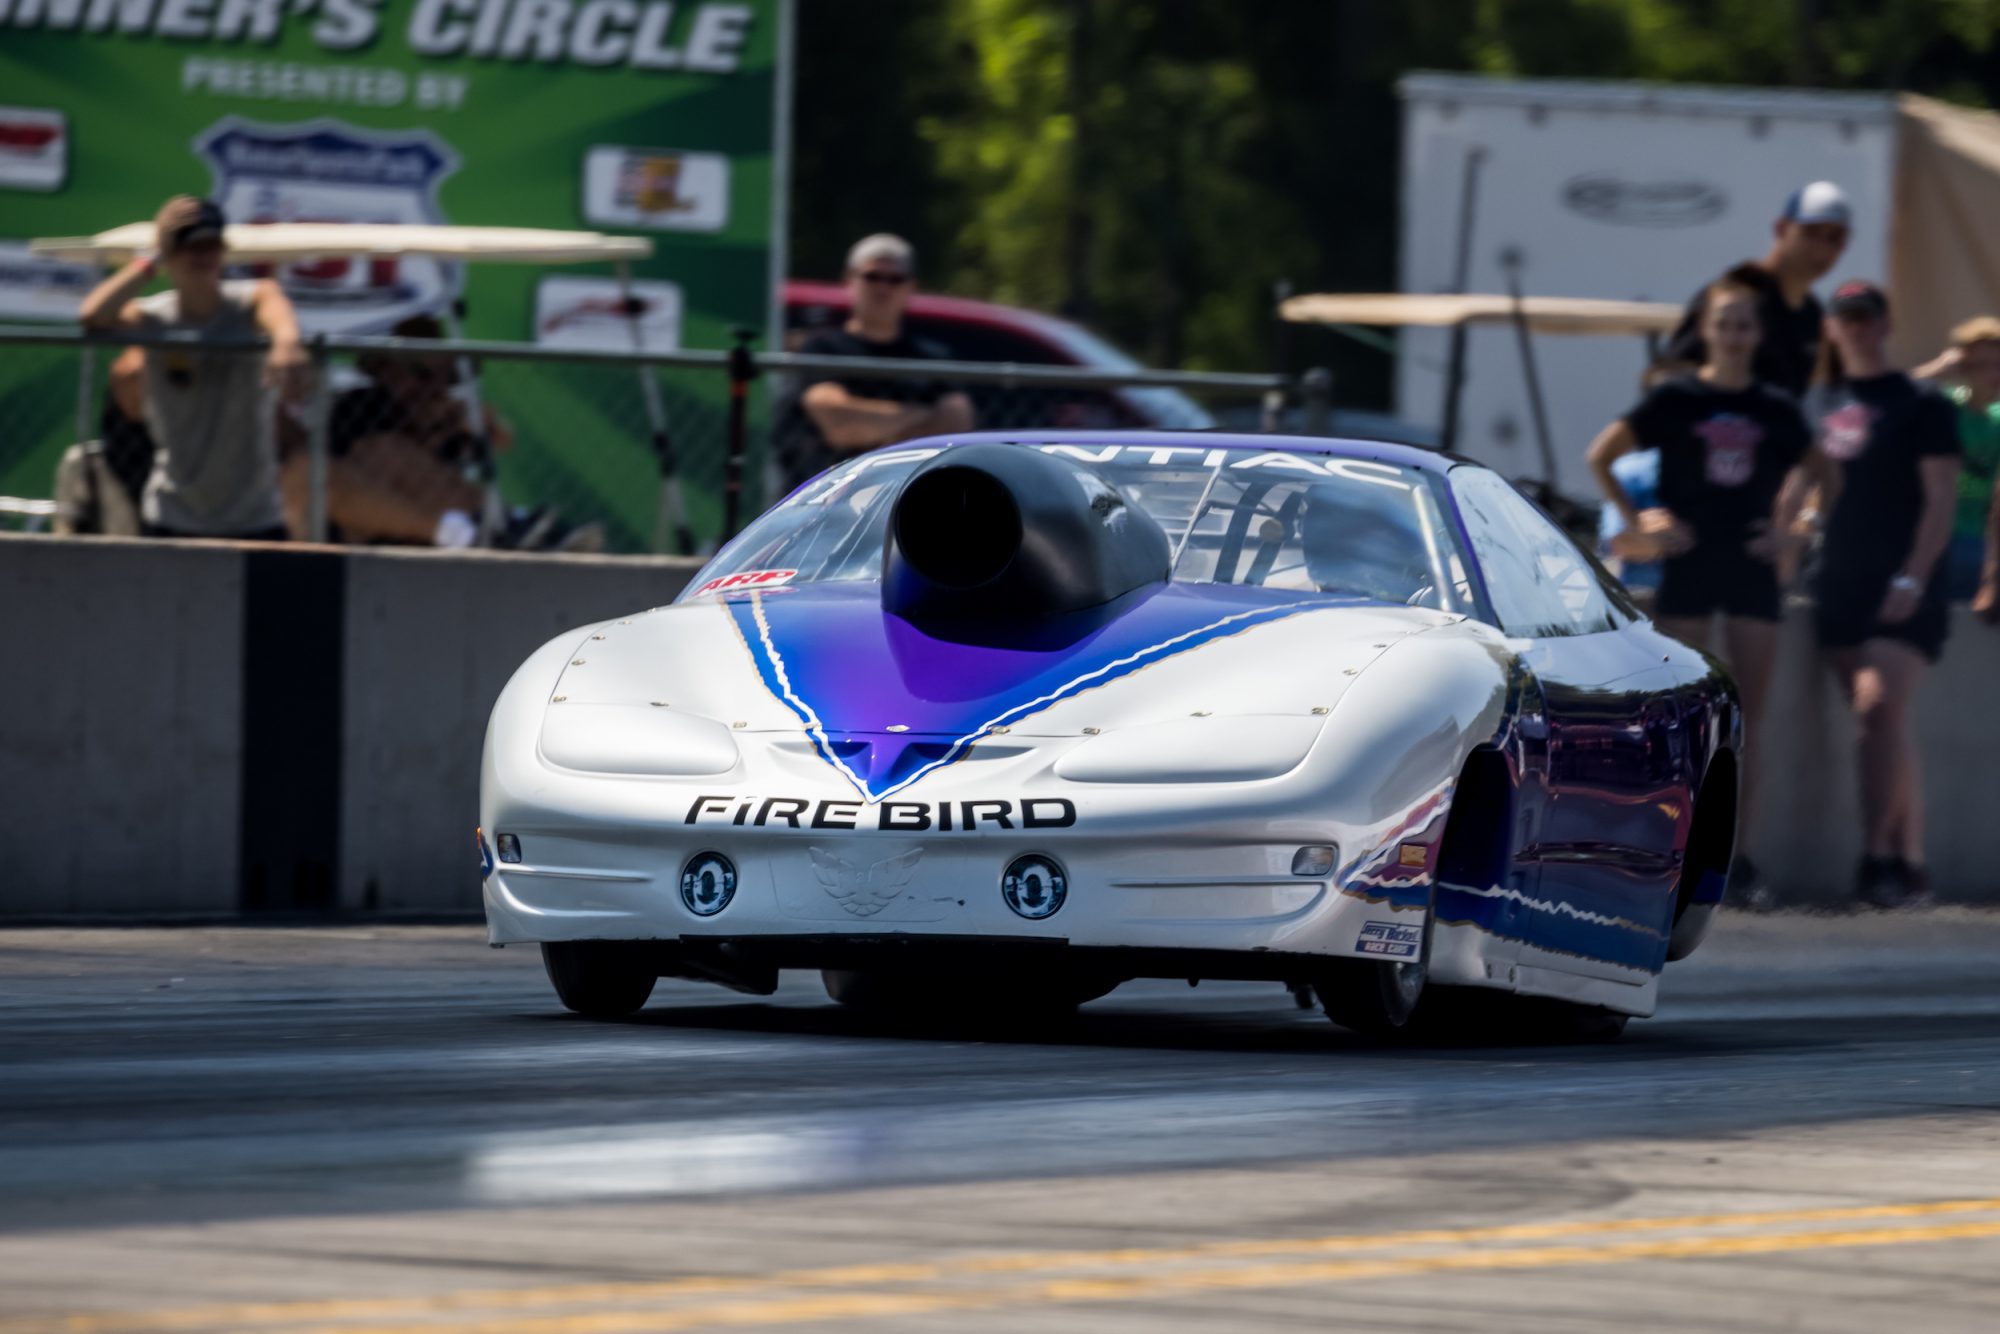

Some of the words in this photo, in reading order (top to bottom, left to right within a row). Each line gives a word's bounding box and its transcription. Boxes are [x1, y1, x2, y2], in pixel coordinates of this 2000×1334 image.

[406, 0, 752, 73] CIRCLE
[182, 56, 405, 106] PRESENTED
[414, 71, 469, 110] BY
[806, 443, 1412, 504] PNTIAC
[693, 570, 796, 597] ARP
